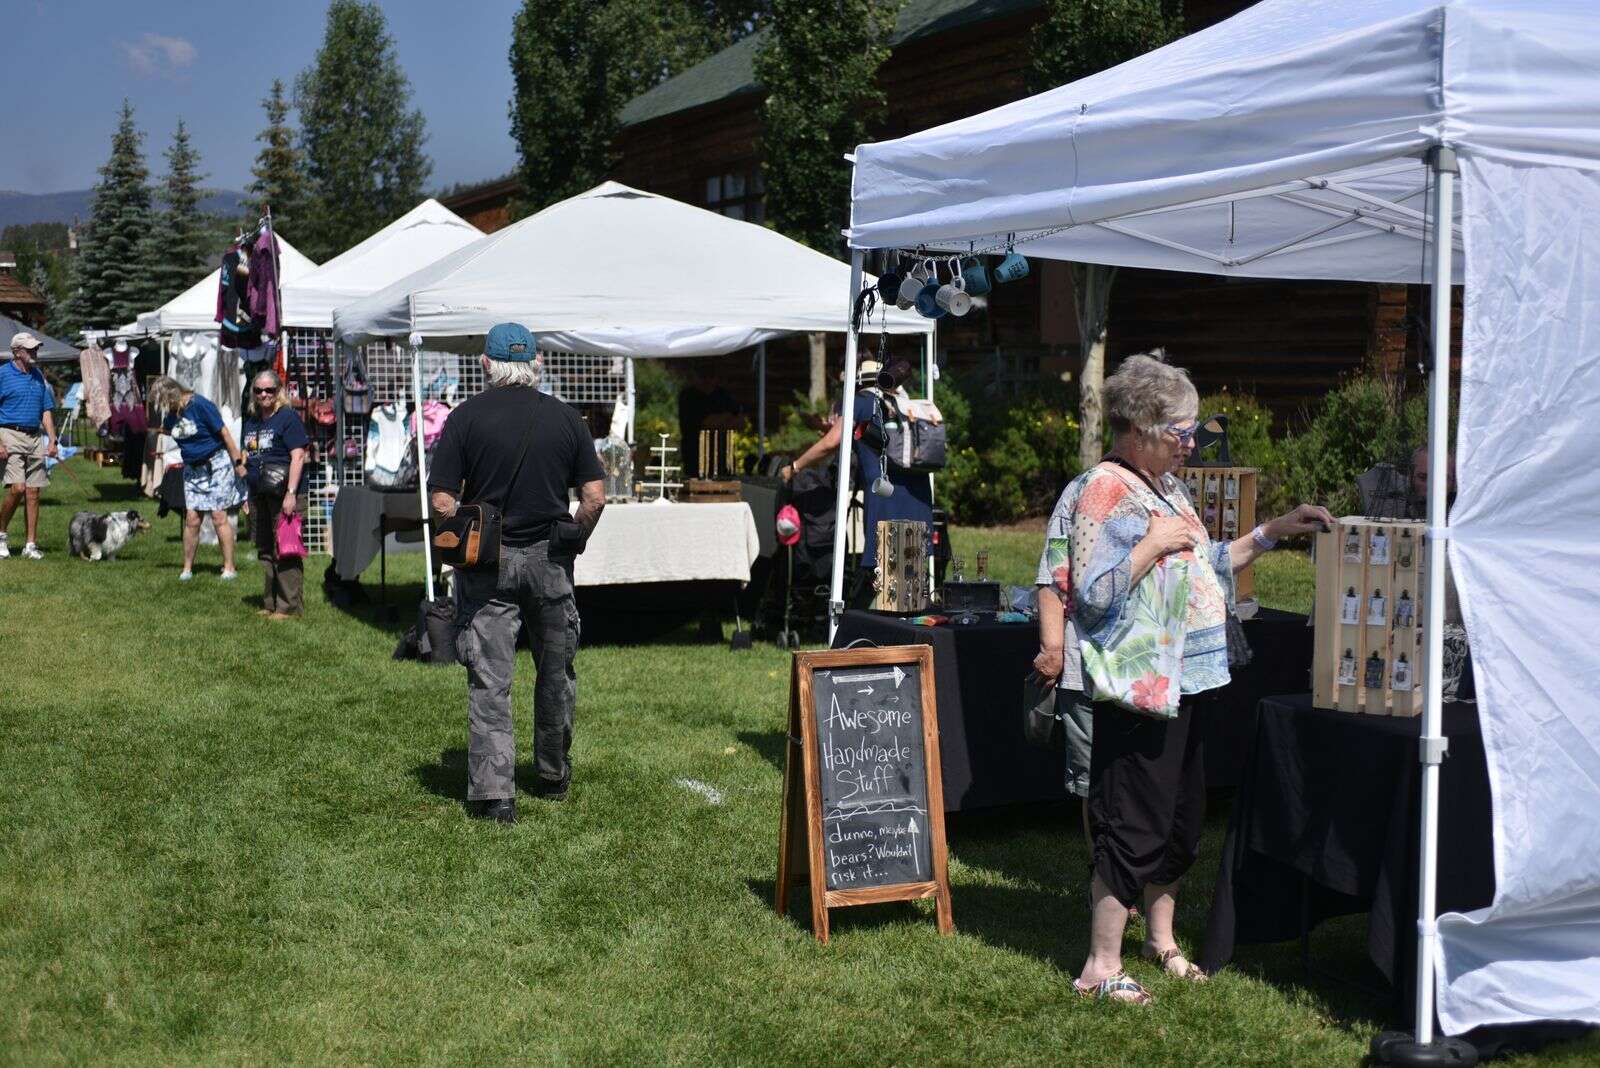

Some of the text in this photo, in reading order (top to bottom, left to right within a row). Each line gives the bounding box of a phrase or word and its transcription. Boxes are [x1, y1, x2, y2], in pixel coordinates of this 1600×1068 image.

[823, 692, 912, 734] Awesome
[823, 732, 911, 770] Handmade
[836, 764, 894, 799] Stuff
[829, 823, 907, 843] dunno, maybe
[830, 844, 874, 868] bears?
[831, 864, 888, 885] risk it...
